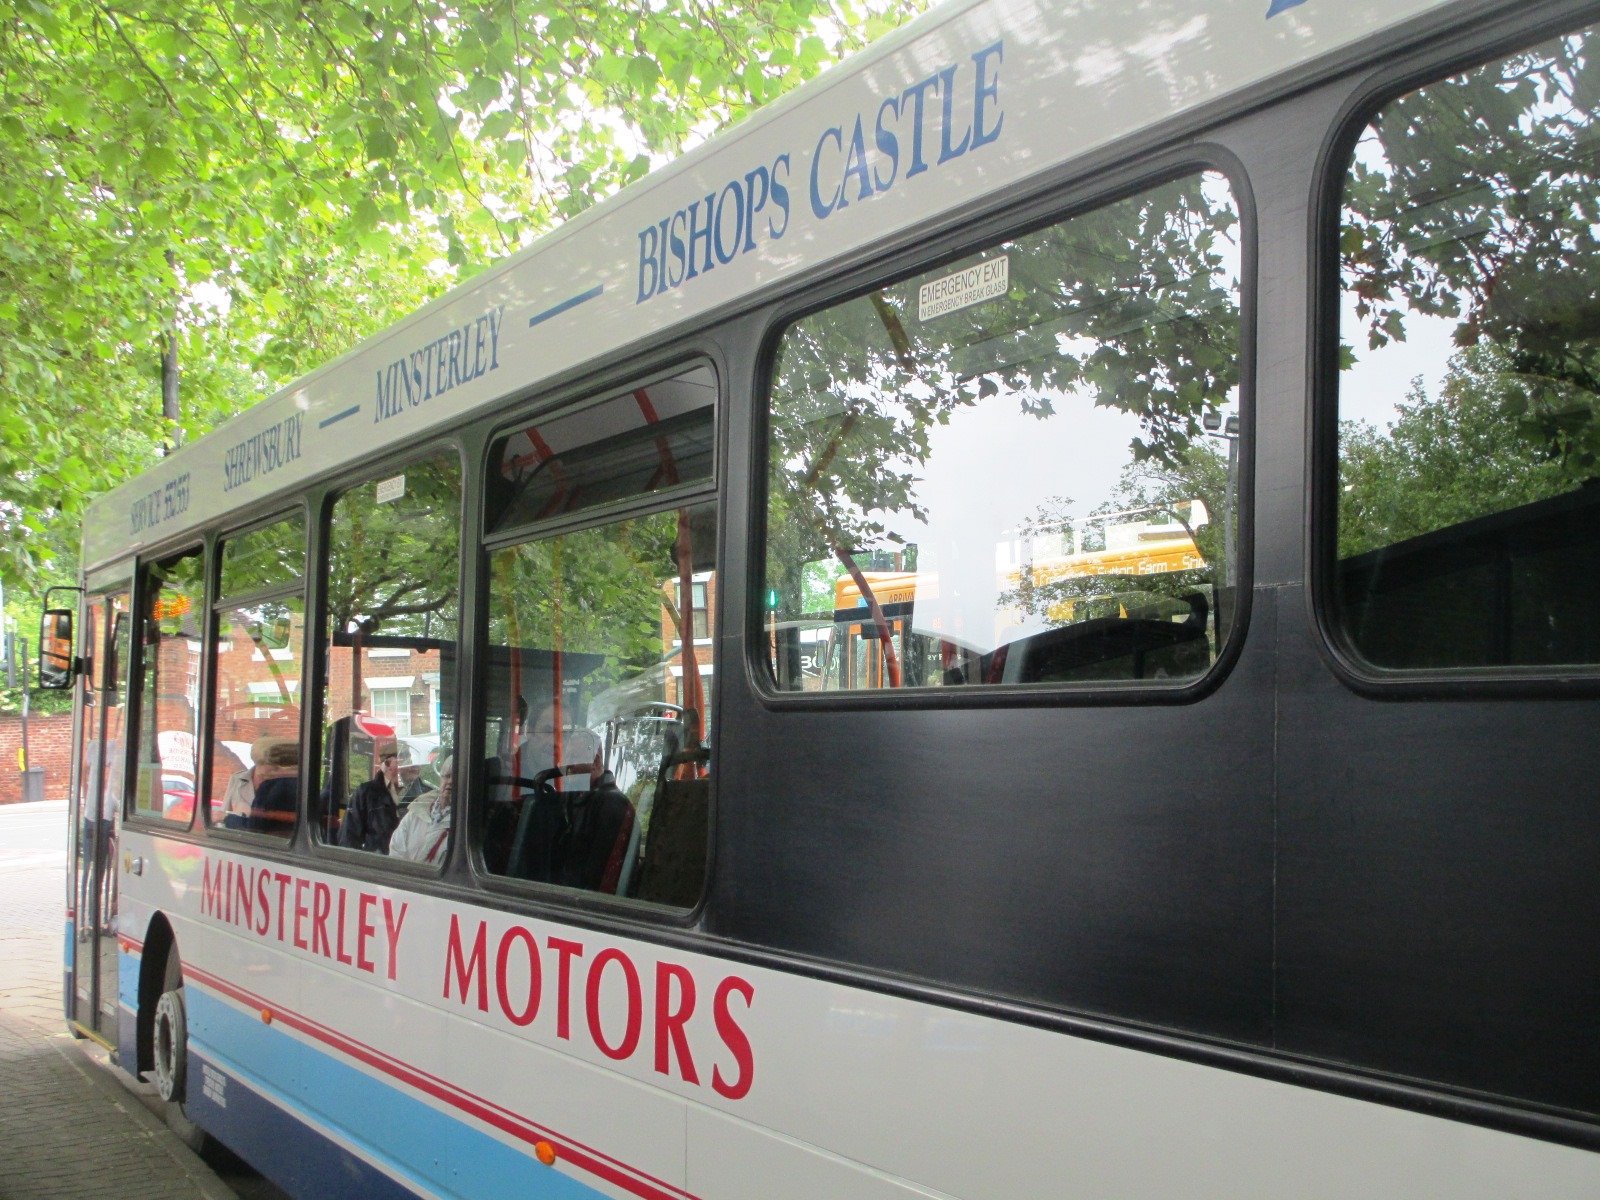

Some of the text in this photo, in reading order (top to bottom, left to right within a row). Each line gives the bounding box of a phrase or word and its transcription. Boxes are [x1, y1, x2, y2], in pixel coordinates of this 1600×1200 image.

[224, 410, 305, 492] SHREWSBURY
[374, 305, 505, 424] MINSTERLEY
[636, 153, 790, 304] BISHOPS
[810, 40, 1005, 220] CASTLE
[921, 258, 1007, 305] EMERGENCY EXIT
[927, 294, 964, 317] EMERGENCY
[964, 287, 985, 303] BREAK
[985, 280, 1006, 297] GLASS
[1138, 561, 1168, 575] Farm
[889, 592, 915, 604] ARRIVA
[200, 856, 755, 1100] MINSTERLEY MOTORS
